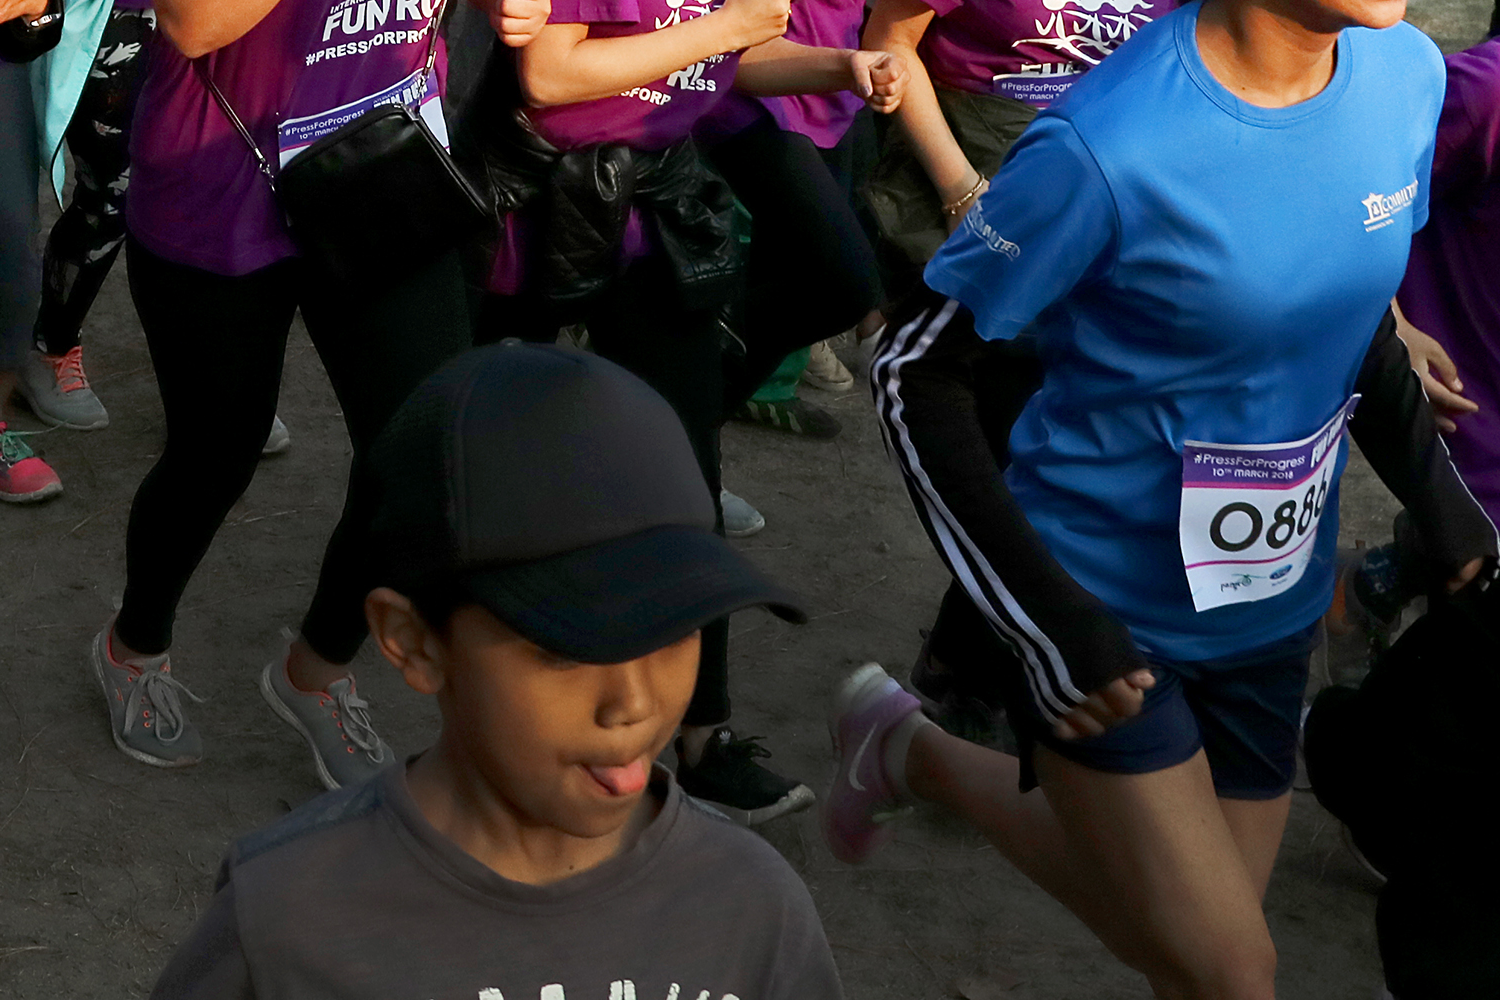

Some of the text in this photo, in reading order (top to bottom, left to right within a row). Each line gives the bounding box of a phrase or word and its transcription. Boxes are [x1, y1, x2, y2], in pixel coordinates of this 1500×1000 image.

[1001, 82, 1073, 93] #PressForProgre
[285, 108, 365, 137] #PressForProgress
[1194, 453, 1306, 472] #PressForProgress
[1234, 468, 1270, 479] MARCH
[1271, 470, 1295, 480] 2018
